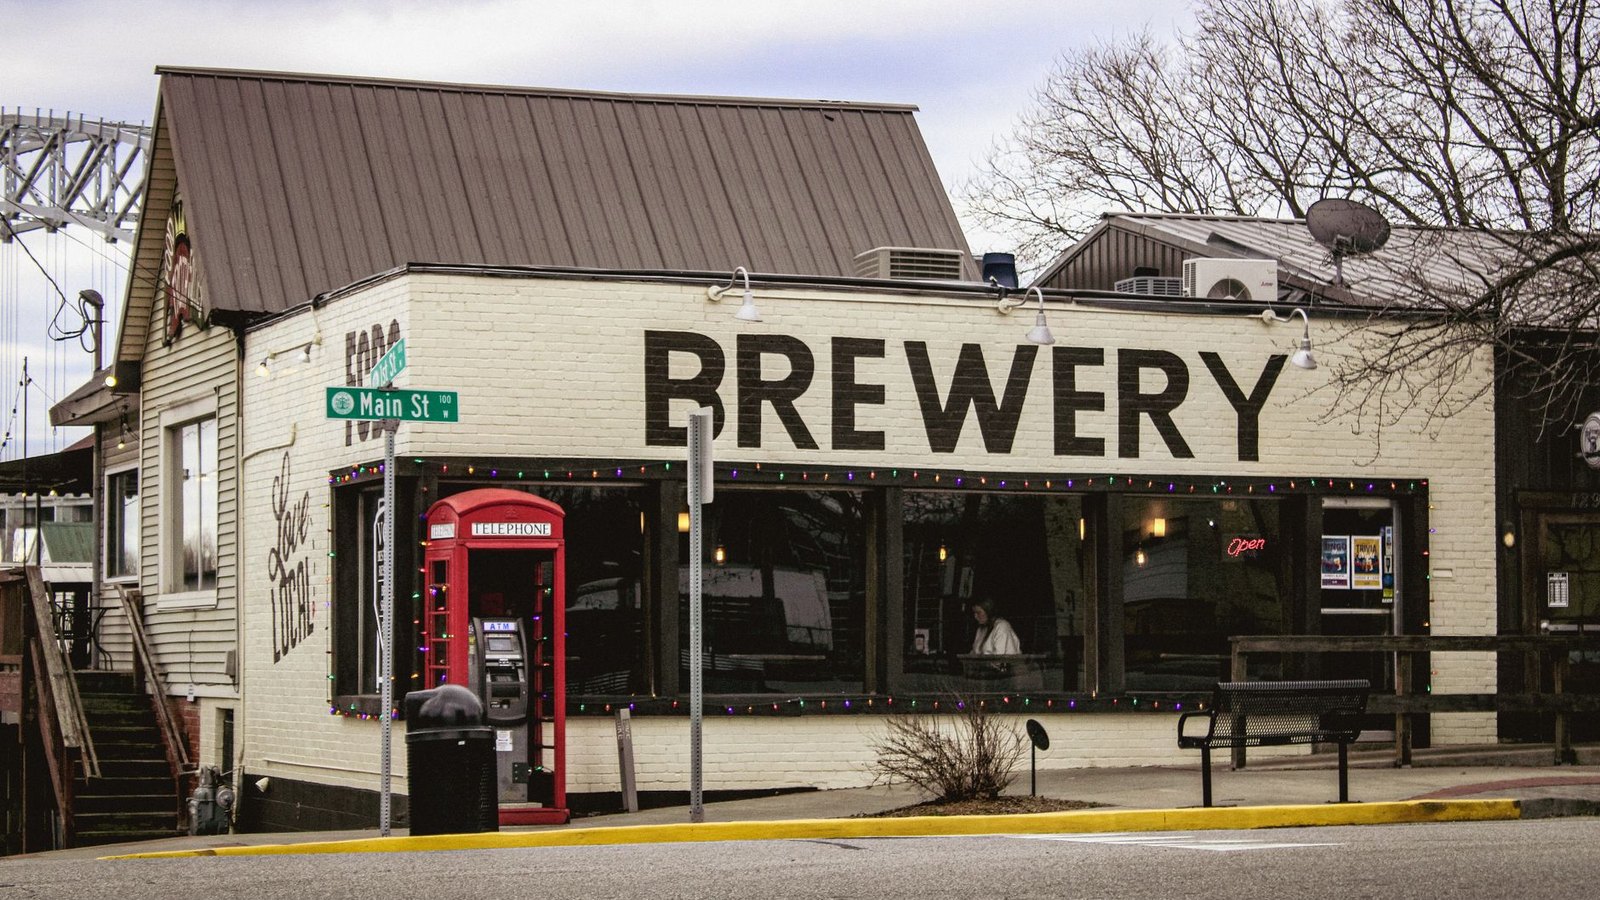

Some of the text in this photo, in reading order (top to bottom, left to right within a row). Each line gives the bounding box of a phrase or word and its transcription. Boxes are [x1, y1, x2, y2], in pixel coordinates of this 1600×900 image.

[389, 350, 397, 377] St
[360, 392, 402, 417] Main
[411, 393, 430, 418] St
[439, 395, 451, 404] 100
[644, 329, 1288, 462] BREWERY
[443, 410, 448, 418] W
[268, 451, 309, 582] Love
[474, 523, 550, 535] TELEPHONE
[1228, 538, 1265, 557] Open
[1356, 544, 1377, 553] TRIVIA
[271, 556, 314, 664] LOCAL
